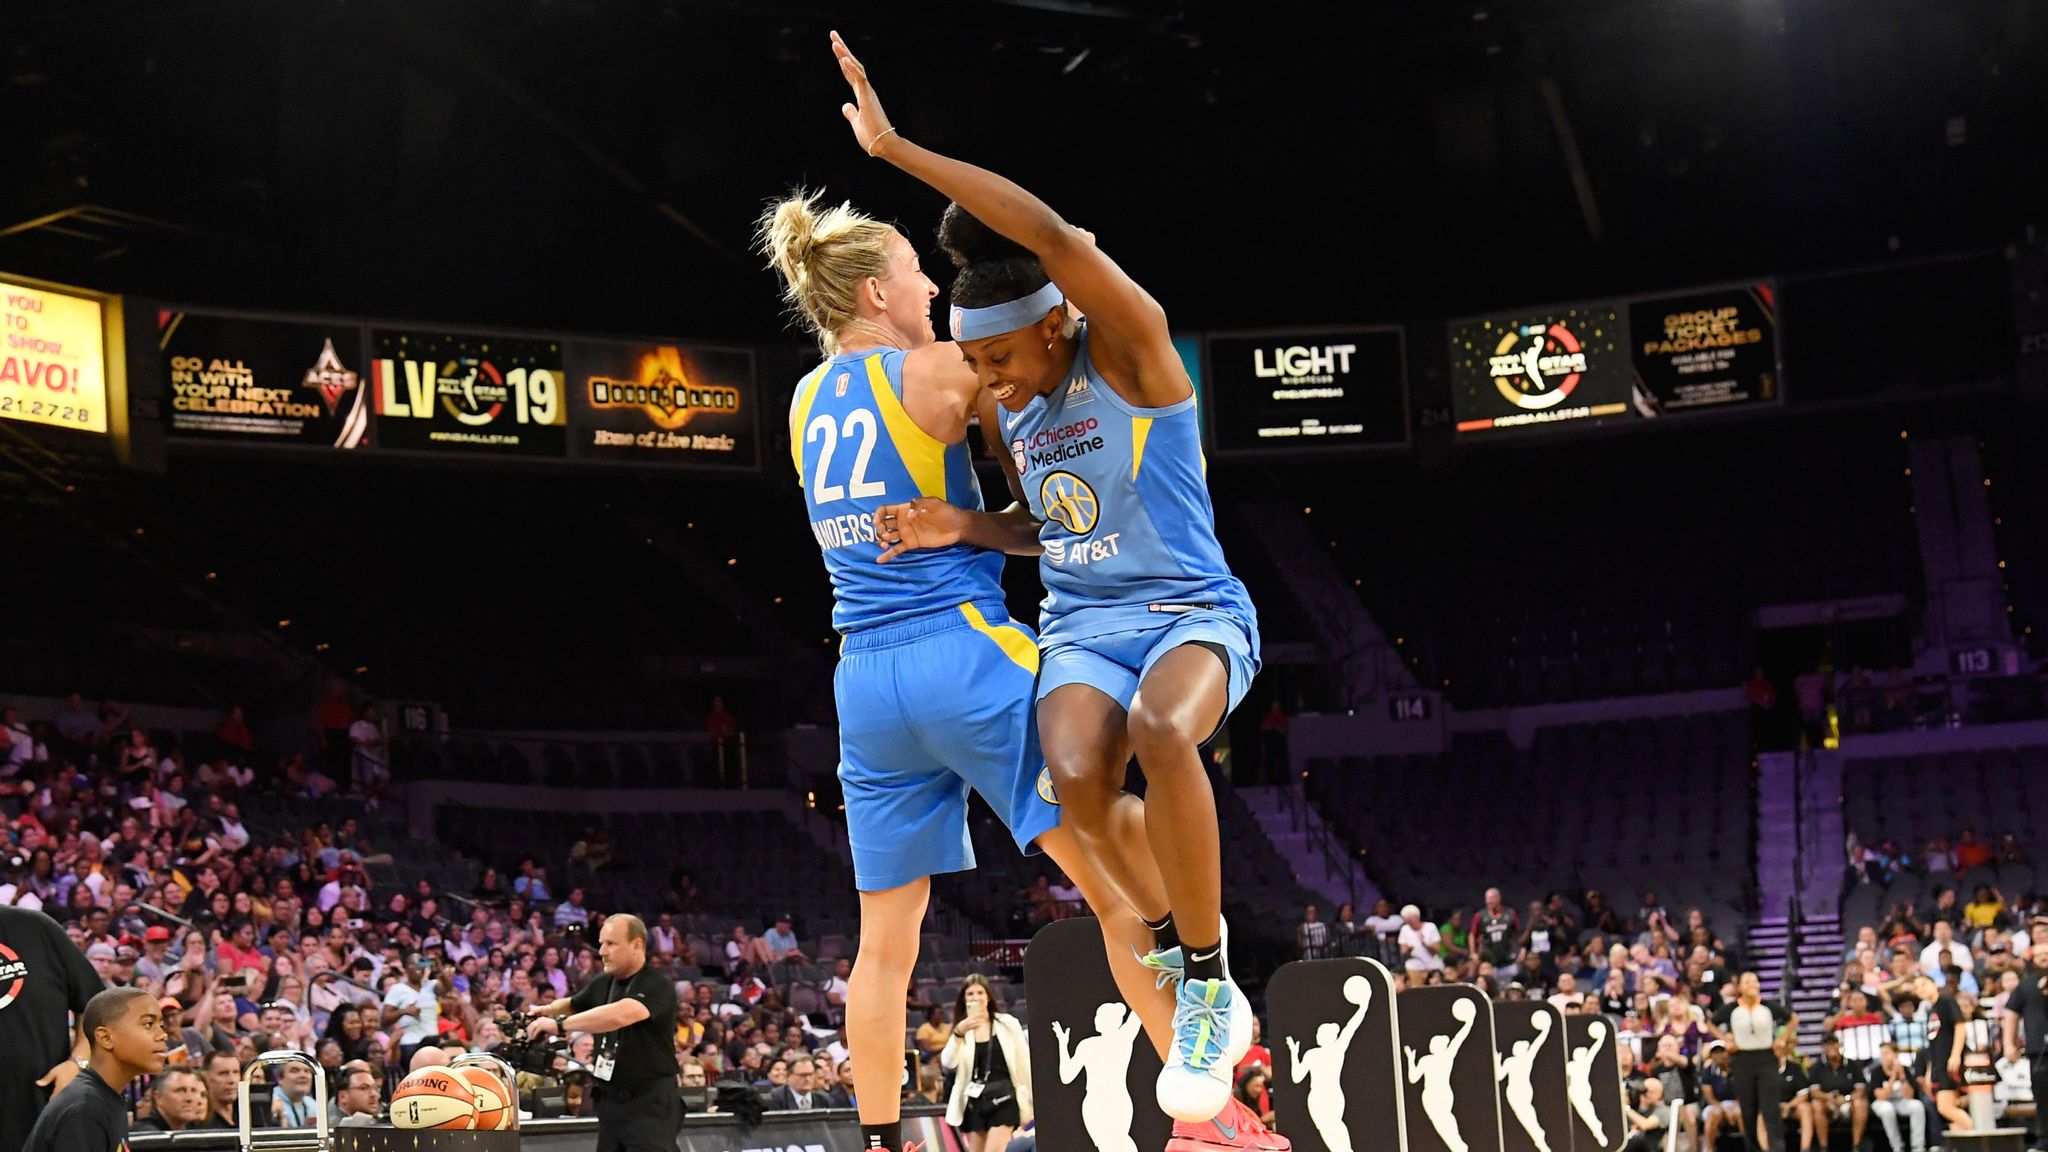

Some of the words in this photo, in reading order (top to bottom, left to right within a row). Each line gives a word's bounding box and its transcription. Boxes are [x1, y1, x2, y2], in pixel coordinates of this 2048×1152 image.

[8, 294, 44, 313] YOU
[6, 313, 28, 330] TO
[1664, 306, 1738, 328] GROUP
[1644, 328, 1761, 355] PACKAGES
[171, 356, 203, 371] GO
[209, 358, 252, 374] ALL
[1254, 344, 1356, 378] LIGHT
[172, 370, 194, 383] IN
[199, 371, 253, 388] WITH
[380, 359, 437, 419] LV
[173, 383, 231, 398] YOUR
[236, 386, 293, 402] NEXT
[506, 367, 558, 426] 19
[173, 397, 320, 418] CELEBRATION
[594, 430, 634, 445] Home
[636, 431, 657, 447] of
[657, 432, 690, 449] Live
[692, 434, 735, 451] Music
[1028, 417, 1099, 450] UChicago
[807, 407, 886, 505] 22
[1031, 437, 1104, 471] Medicine
[1069, 533, 1121, 565] AT&T
[1959, 649, 1990, 672] 113
[1396, 698, 1424, 719] 114
